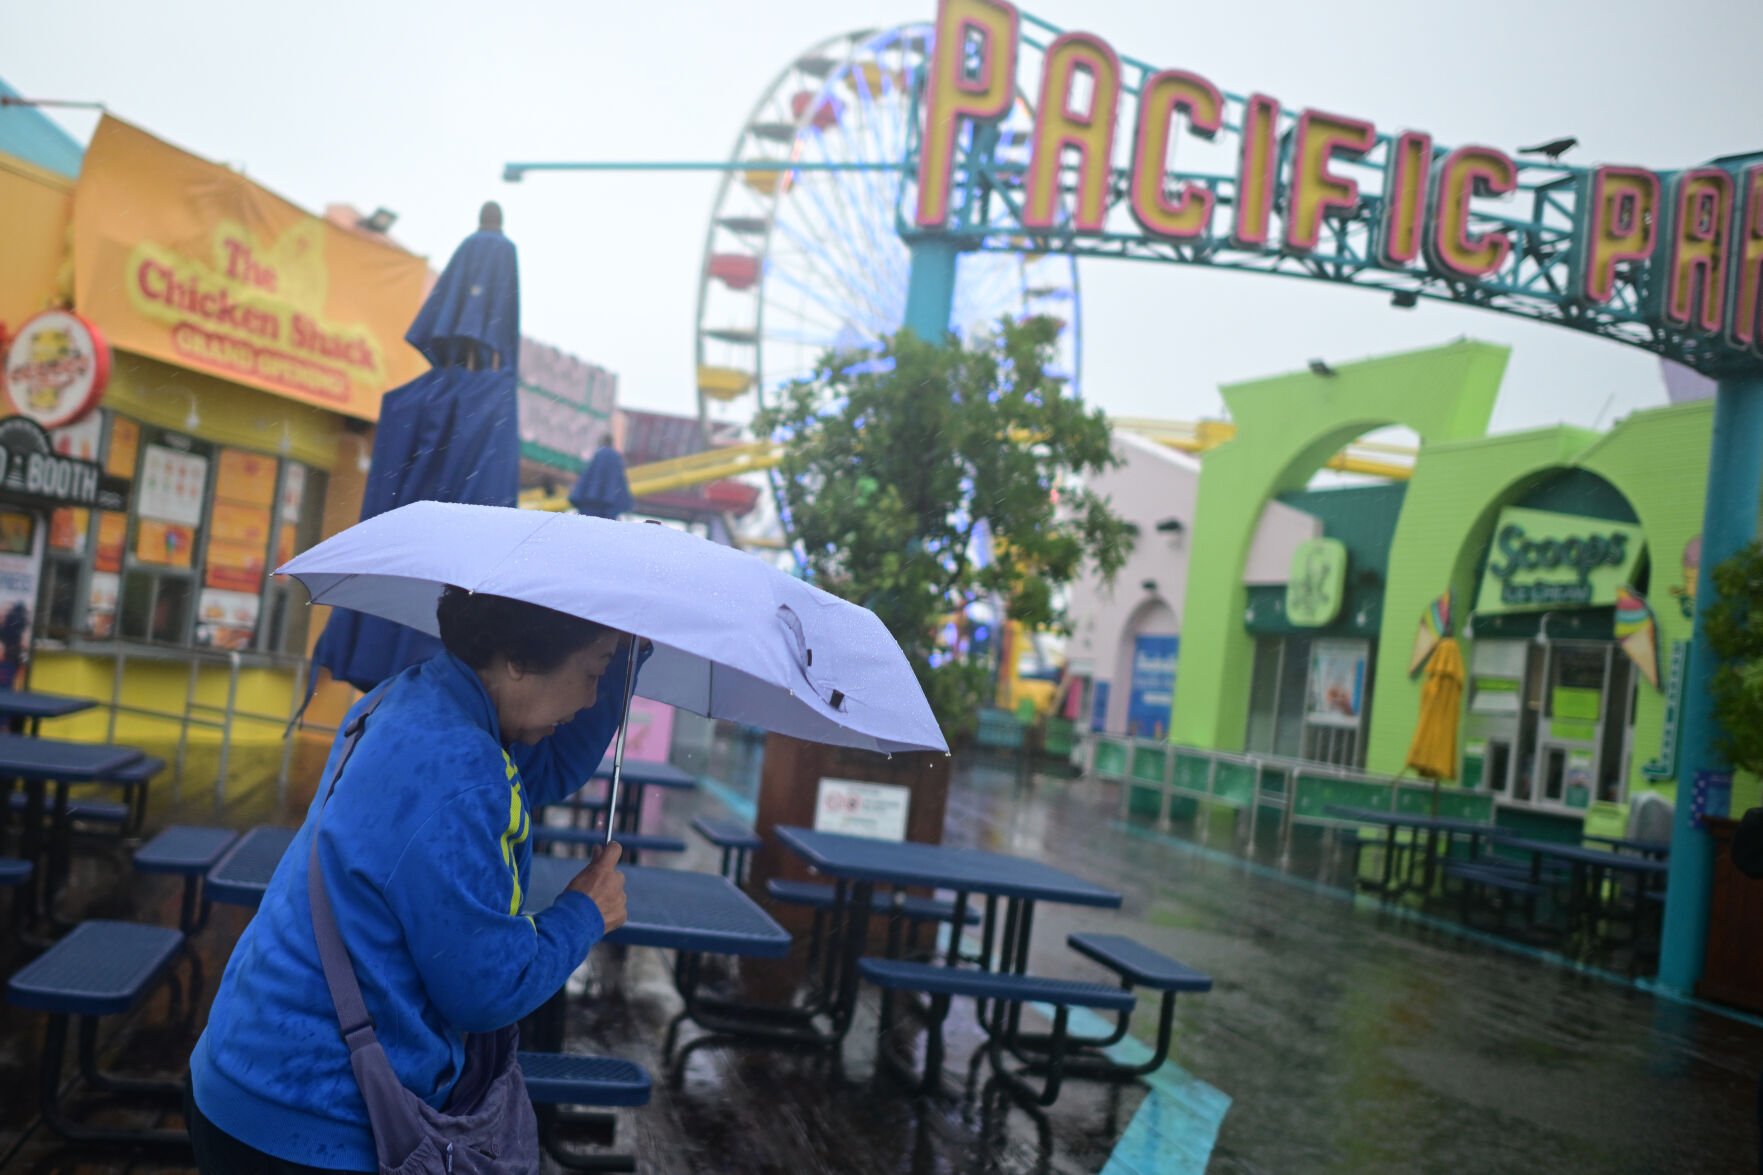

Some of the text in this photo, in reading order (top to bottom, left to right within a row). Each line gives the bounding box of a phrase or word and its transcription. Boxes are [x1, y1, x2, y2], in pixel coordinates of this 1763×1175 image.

[917, 0, 1517, 277] PACIFIC
[222, 236, 279, 291] The
[137, 257, 376, 372] Chicken Shack
[27, 451, 98, 502] BOOTH
[1490, 523, 1628, 588] Scoops
